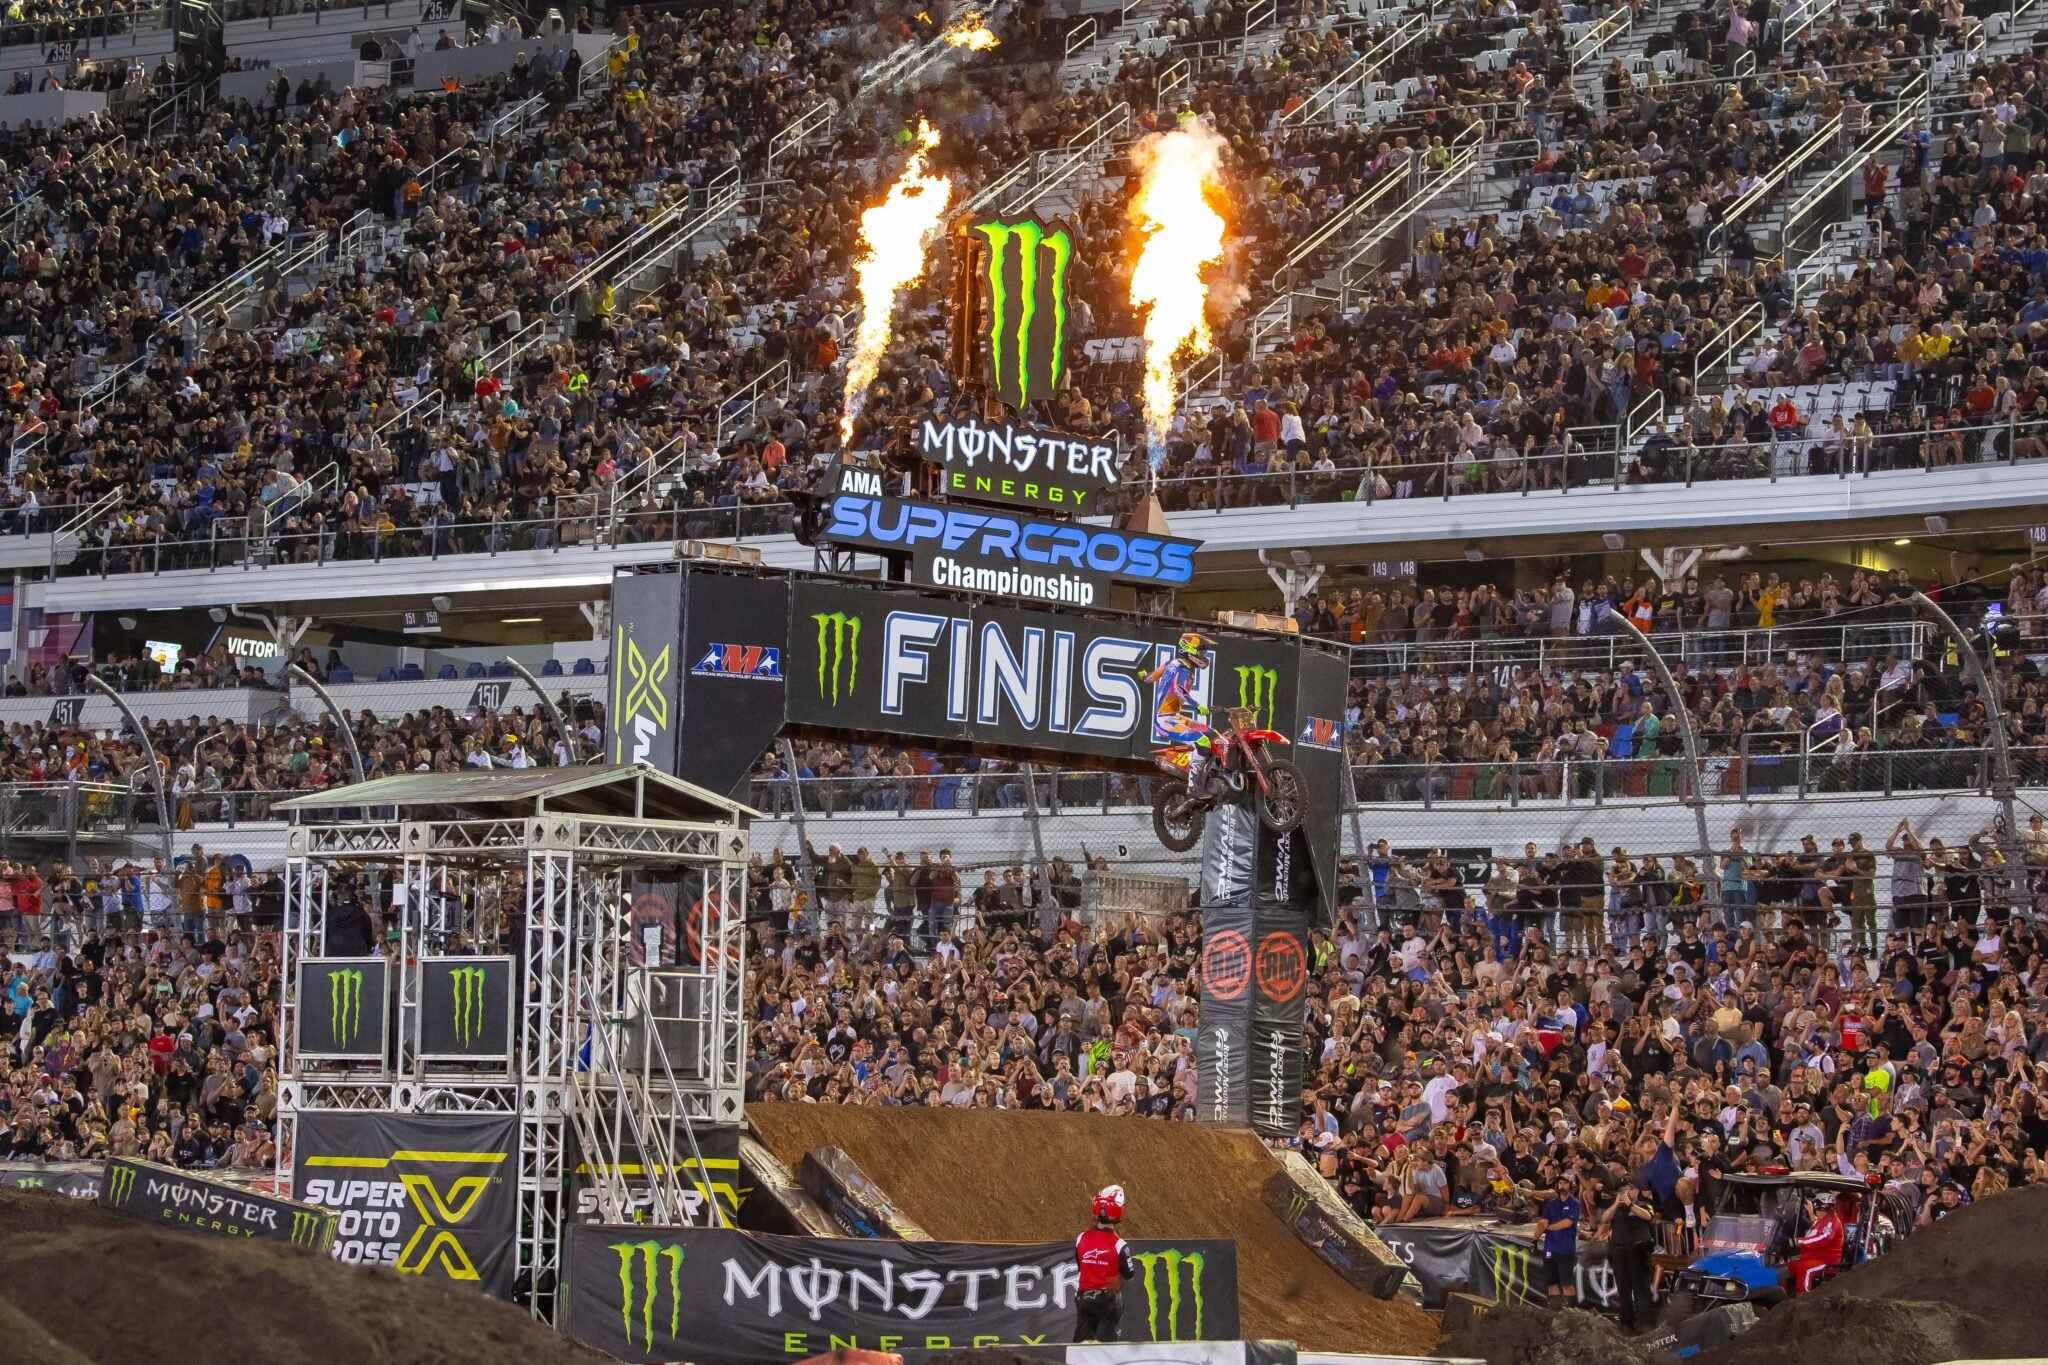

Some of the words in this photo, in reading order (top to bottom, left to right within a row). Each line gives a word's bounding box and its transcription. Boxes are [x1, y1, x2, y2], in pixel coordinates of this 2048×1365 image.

[53, 42, 72, 62] 359
[921, 419, 1118, 485] MONSTER
[841, 470, 882, 497] AMA
[953, 472, 1087, 505] ENERGY
[826, 497, 1199, 582] SUPERCROSS
[2029, 526, 2047, 542] 148
[932, 556, 1093, 606] Championship
[1372, 561, 1387, 577] 149
[1399, 560, 1415, 576] 148
[404, 612, 417, 625] 151
[426, 611, 438, 624] 150
[691, 642, 784, 677] AMA
[477, 685, 500, 709] 150
[55, 701, 74, 724] 151
[1297, 715, 1342, 749] AMA
[1118, 844, 1128, 857] D
[147, 1178, 278, 1230] MONSTER
[303, 1179, 407, 1208] SUPER
[162, 1208, 255, 1239] ENERGY
[337, 1210, 401, 1238] OTO
[330, 1240, 402, 1266] ROSS
[722, 1258, 1080, 1321] MONSTER
